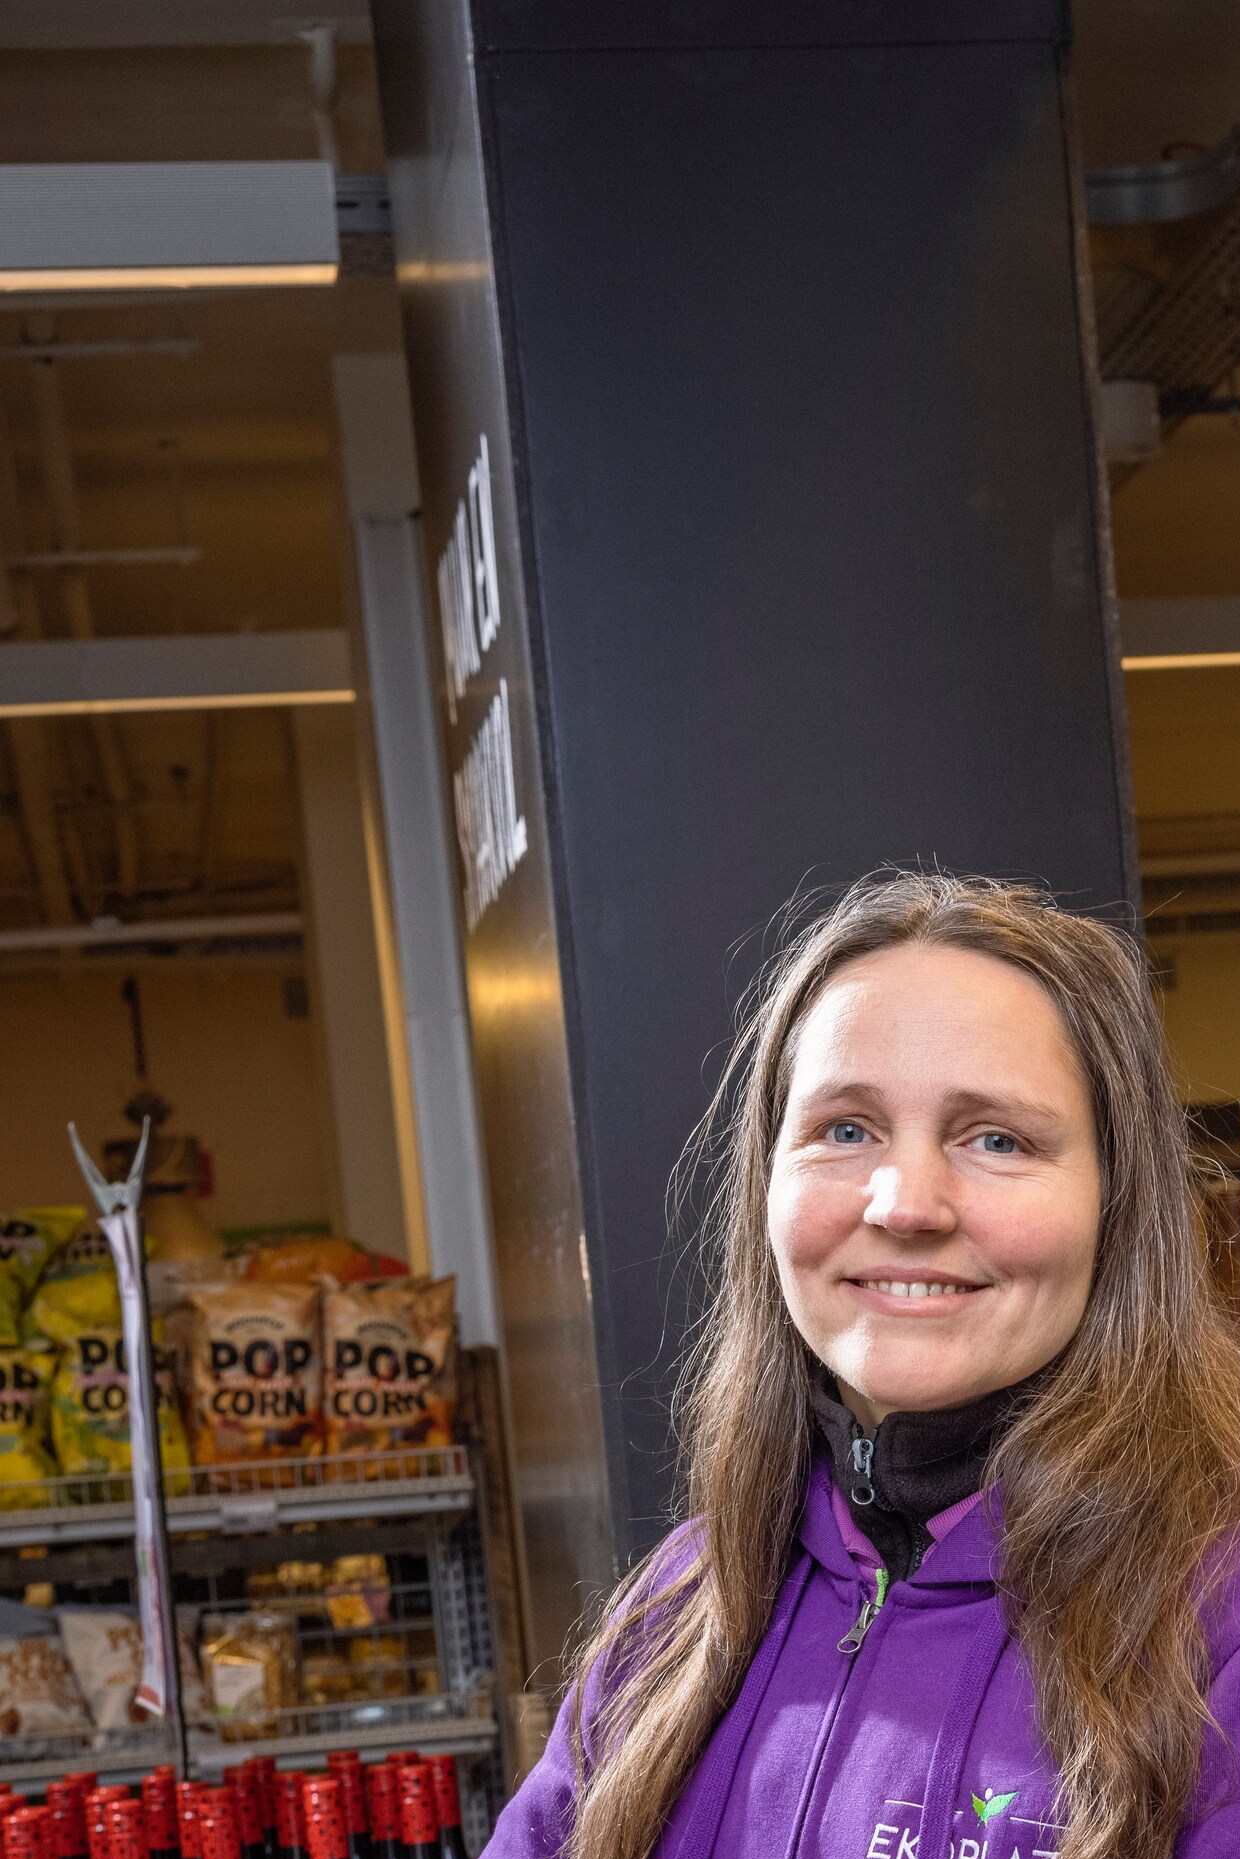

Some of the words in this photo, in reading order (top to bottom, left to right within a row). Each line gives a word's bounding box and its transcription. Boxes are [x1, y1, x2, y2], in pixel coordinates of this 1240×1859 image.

[210, 1338, 312, 1379] POP
[335, 1339, 434, 1381] POP
[212, 1387, 307, 1417] CORN
[333, 1388, 427, 1417] CORN
